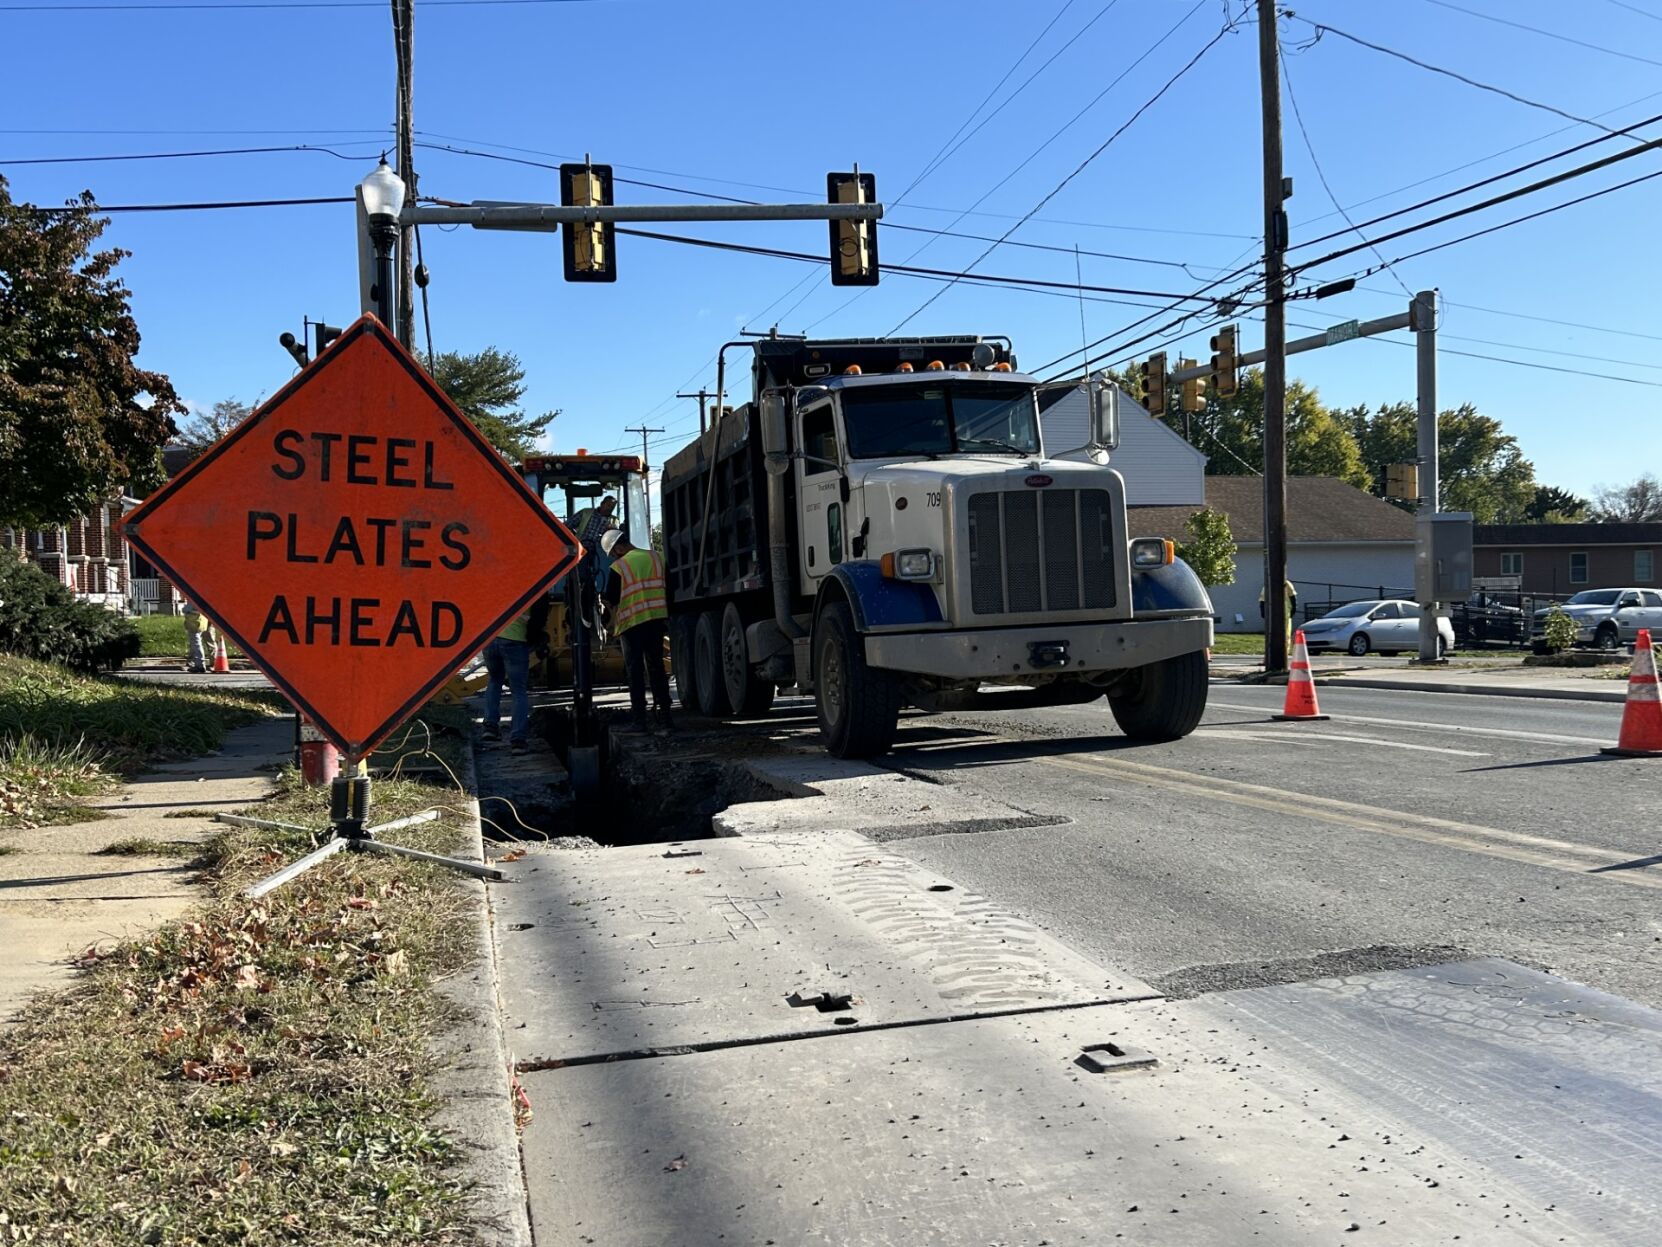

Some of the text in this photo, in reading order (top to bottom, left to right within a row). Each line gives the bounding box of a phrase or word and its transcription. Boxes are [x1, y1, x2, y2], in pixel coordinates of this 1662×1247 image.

[271, 429, 454, 490] STEEL
[926, 492, 942, 508] 709
[246, 510, 471, 571] PLATES
[258, 595, 464, 648] AHEAD
